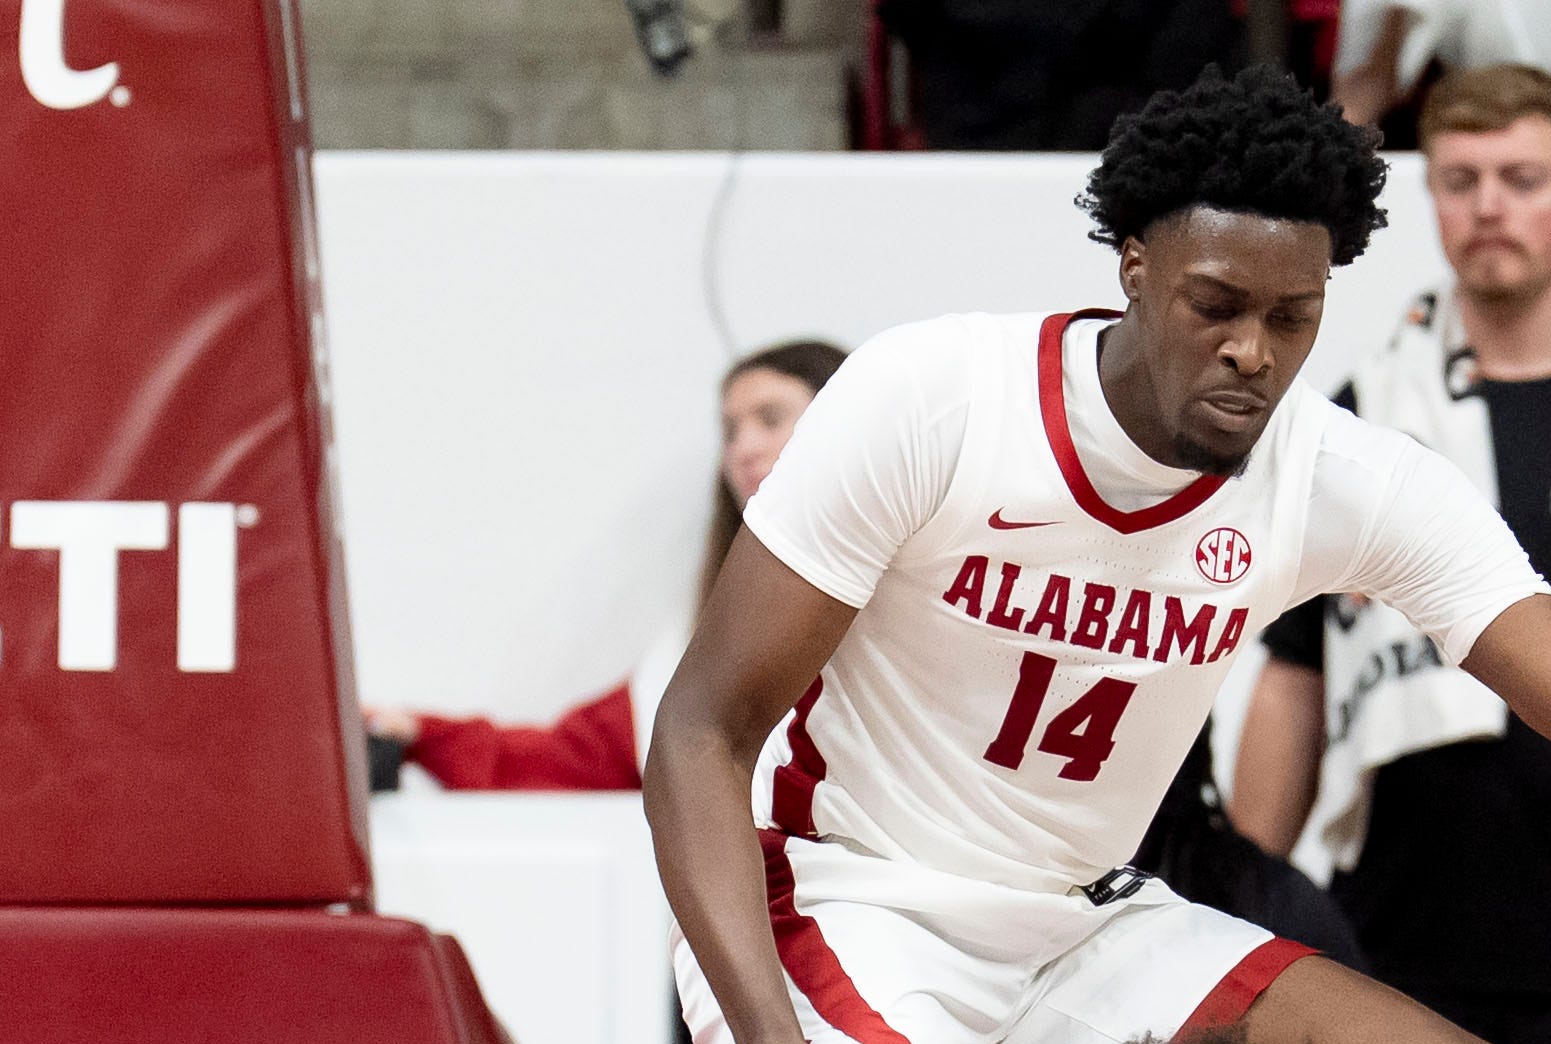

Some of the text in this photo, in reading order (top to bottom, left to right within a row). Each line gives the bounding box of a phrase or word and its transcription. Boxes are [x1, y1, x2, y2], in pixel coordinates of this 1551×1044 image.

[0, 501, 237, 672] TI
[942, 555, 1249, 665] ALABAMA
[1196, 527, 1252, 583] SEC
[983, 650, 1138, 781] 14
